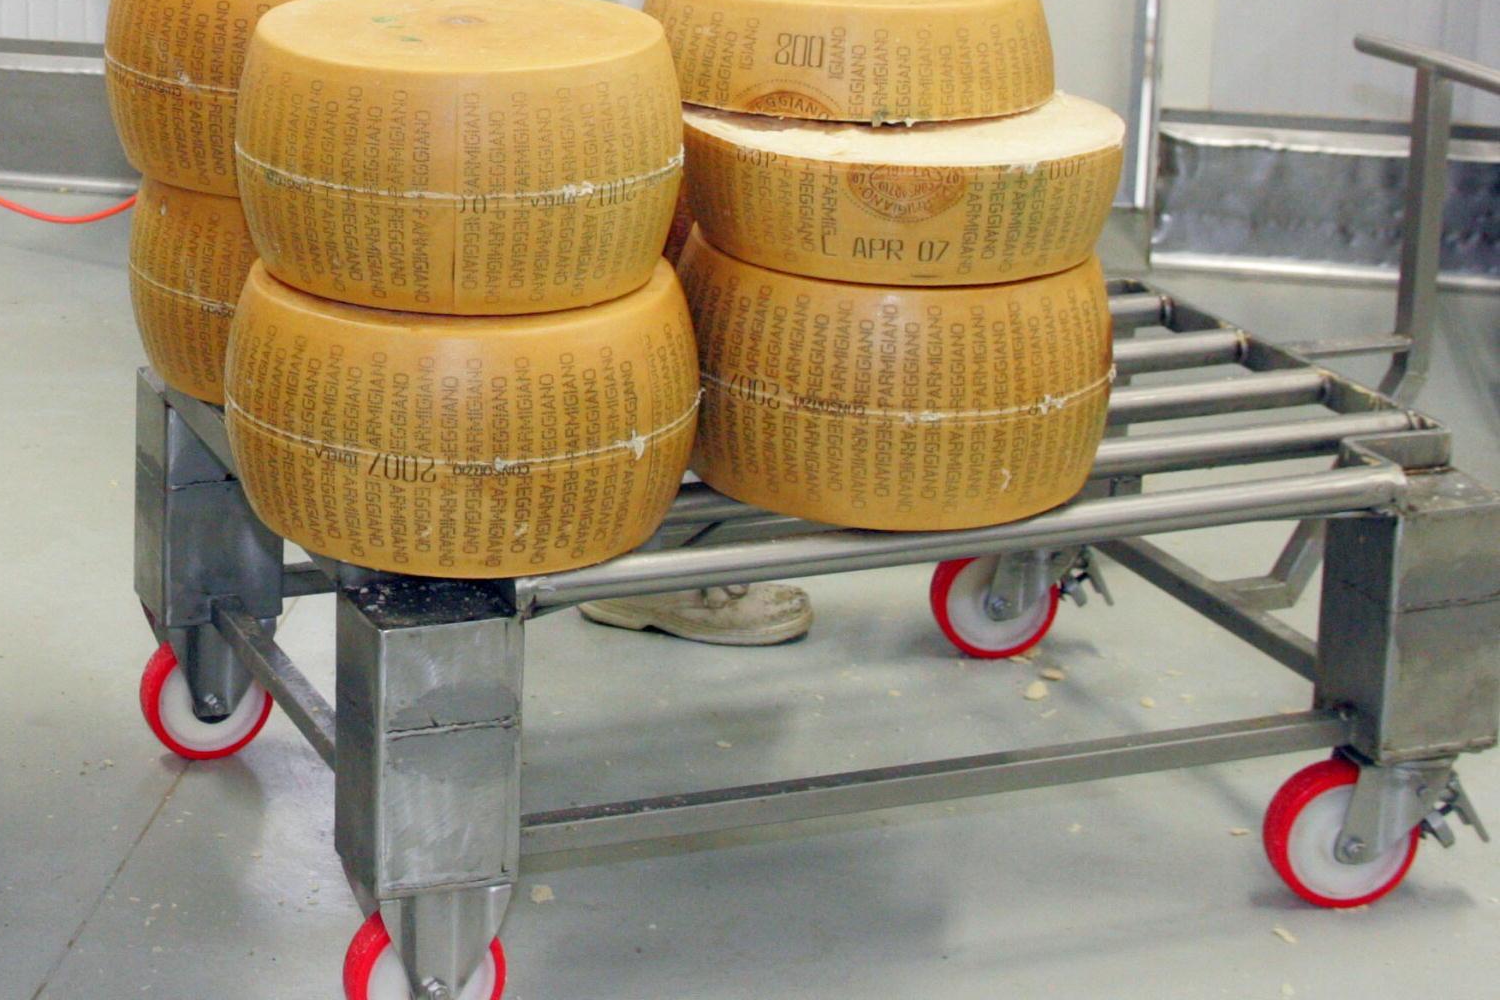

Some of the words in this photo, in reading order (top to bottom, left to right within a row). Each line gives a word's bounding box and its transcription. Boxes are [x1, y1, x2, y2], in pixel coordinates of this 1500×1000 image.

[775, 32, 825, 68] 800
[849, 44, 866, 119] EGGIANO
[895, 46, 911, 118] EGGIANO
[852, 237, 904, 261] APR
[917, 240, 950, 262] 07
[368, 454, 437, 483] 2007
